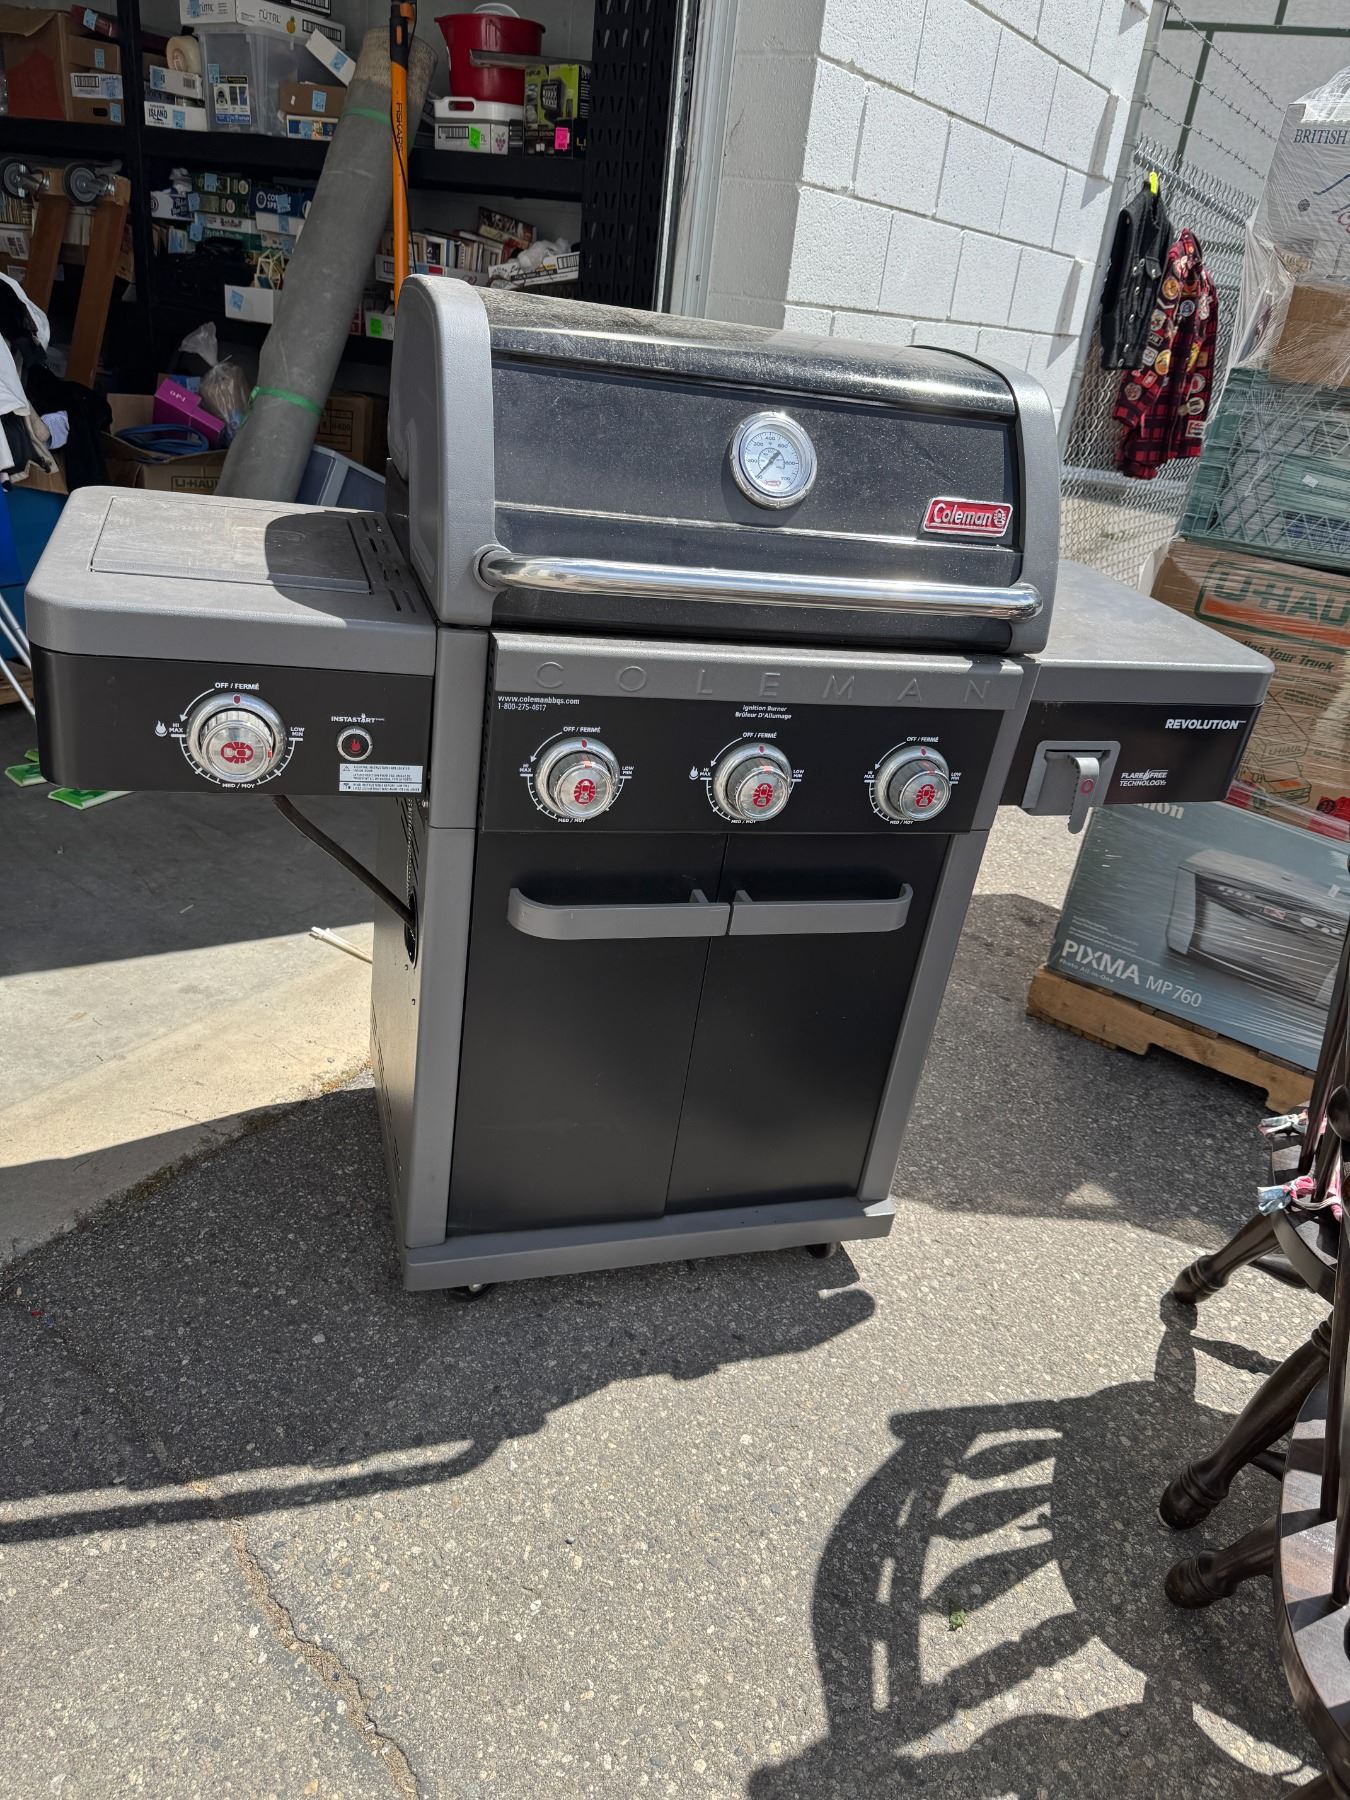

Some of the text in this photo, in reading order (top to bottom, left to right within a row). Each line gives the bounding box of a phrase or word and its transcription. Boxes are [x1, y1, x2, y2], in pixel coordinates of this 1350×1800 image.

[1293, 128, 1348, 145] BRITISH
[933, 502, 992, 526] Coleman
[1269, 646, 1297, 663] Your
[1298, 654, 1336, 673] Truck
[534, 661, 991, 703] COLEMAN
[498, 695, 580, 705] www.colemanbbqs.com
[742, 704, 766, 712] Ignition
[331, 714, 375, 723] INSTASTART
[1165, 718, 1240, 730] REVOLUTION
[1150, 771, 1168, 779] FREE
[1119, 779, 1167, 787] TECHNOLOGY
[1061, 939, 1140, 985] PIXMA
[1145, 975, 1202, 1008] MP760
